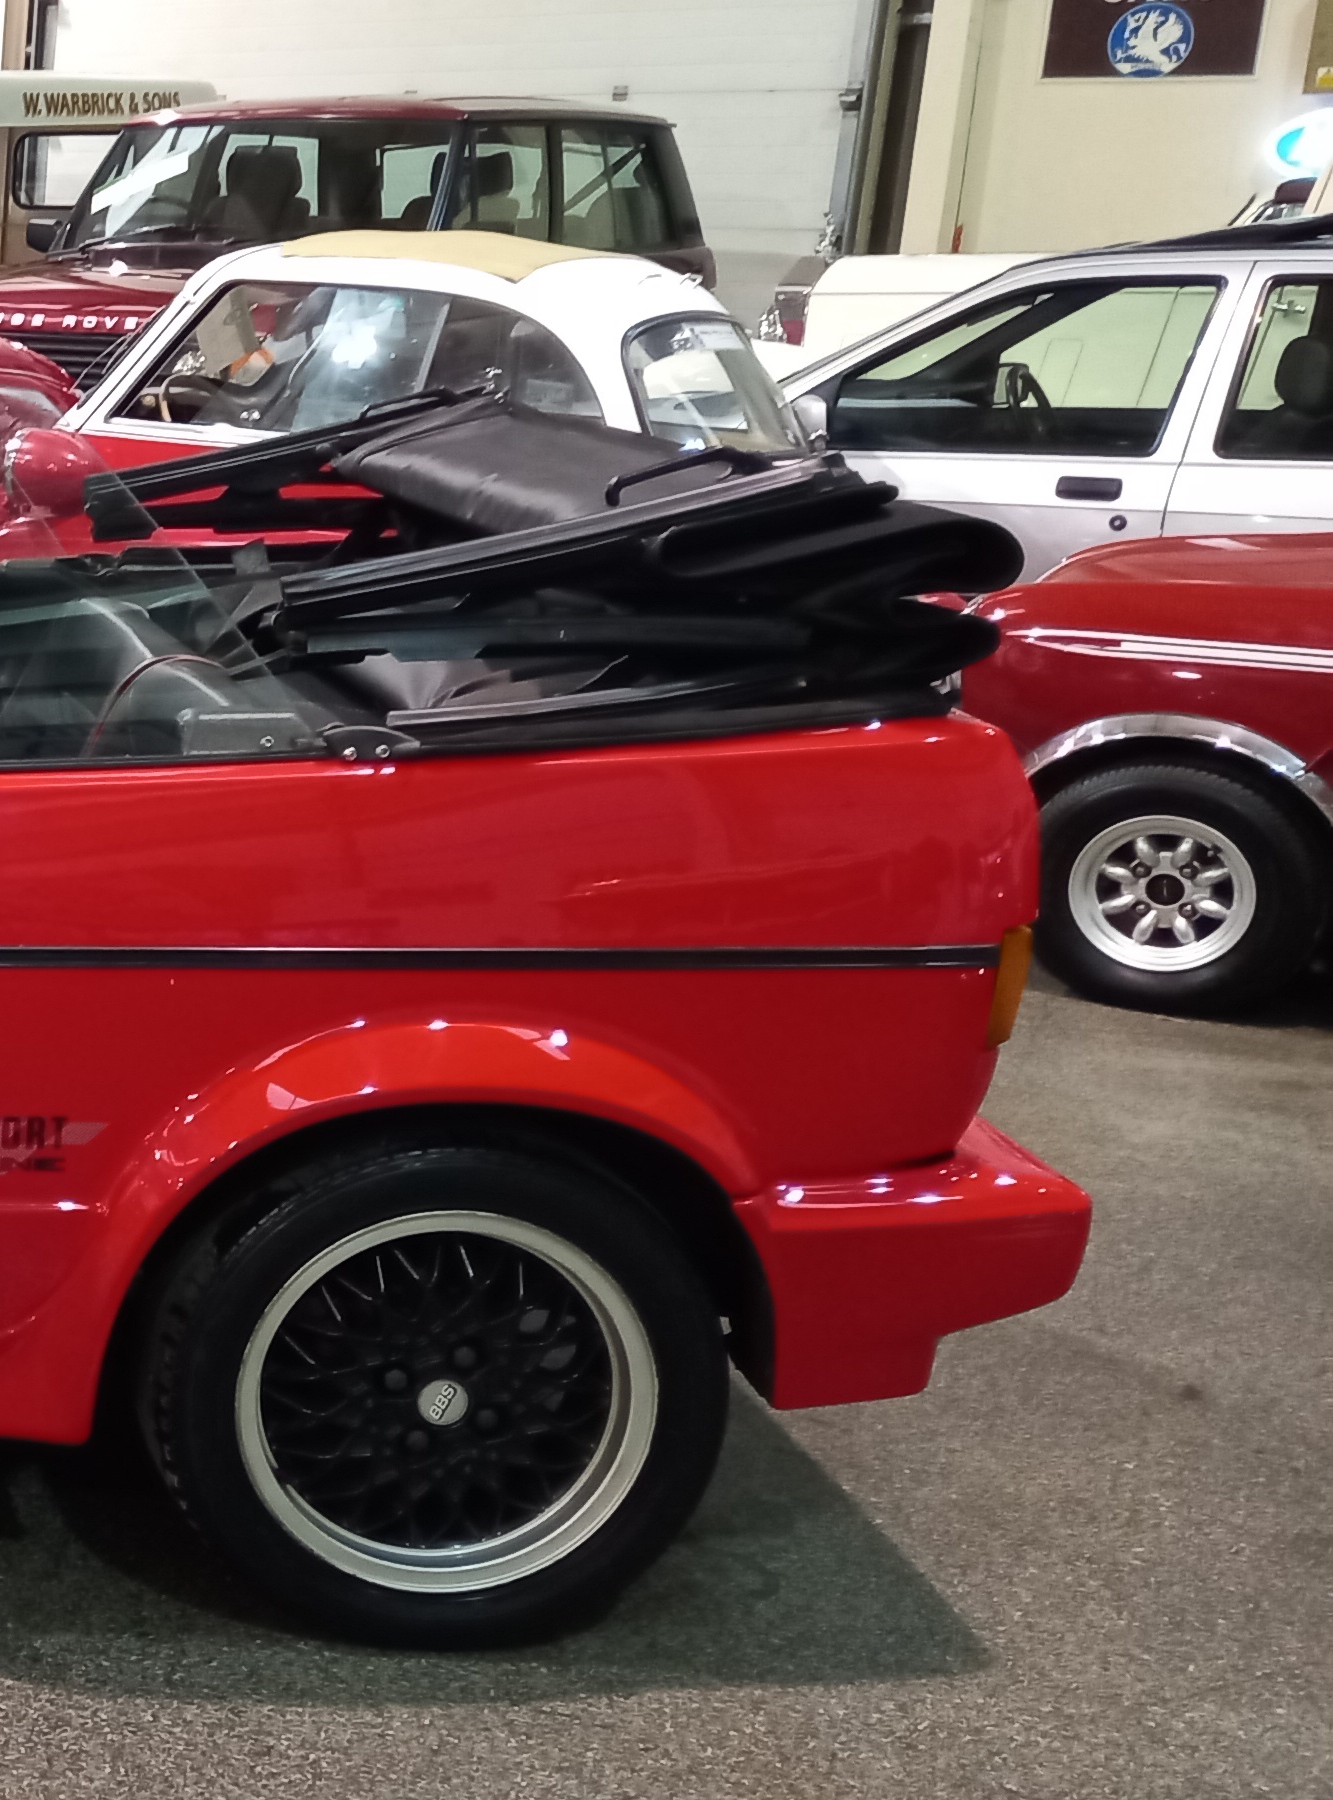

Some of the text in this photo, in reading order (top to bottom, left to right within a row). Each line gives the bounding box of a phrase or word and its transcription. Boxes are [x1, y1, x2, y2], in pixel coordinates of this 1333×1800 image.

[43, 92, 125, 117] WARBRICK
[129, 92, 140, 114] &
[142, 92, 181, 113] SONS
[61, 314, 139, 330] ROVE
[429, 1384, 456, 1420] BBS
